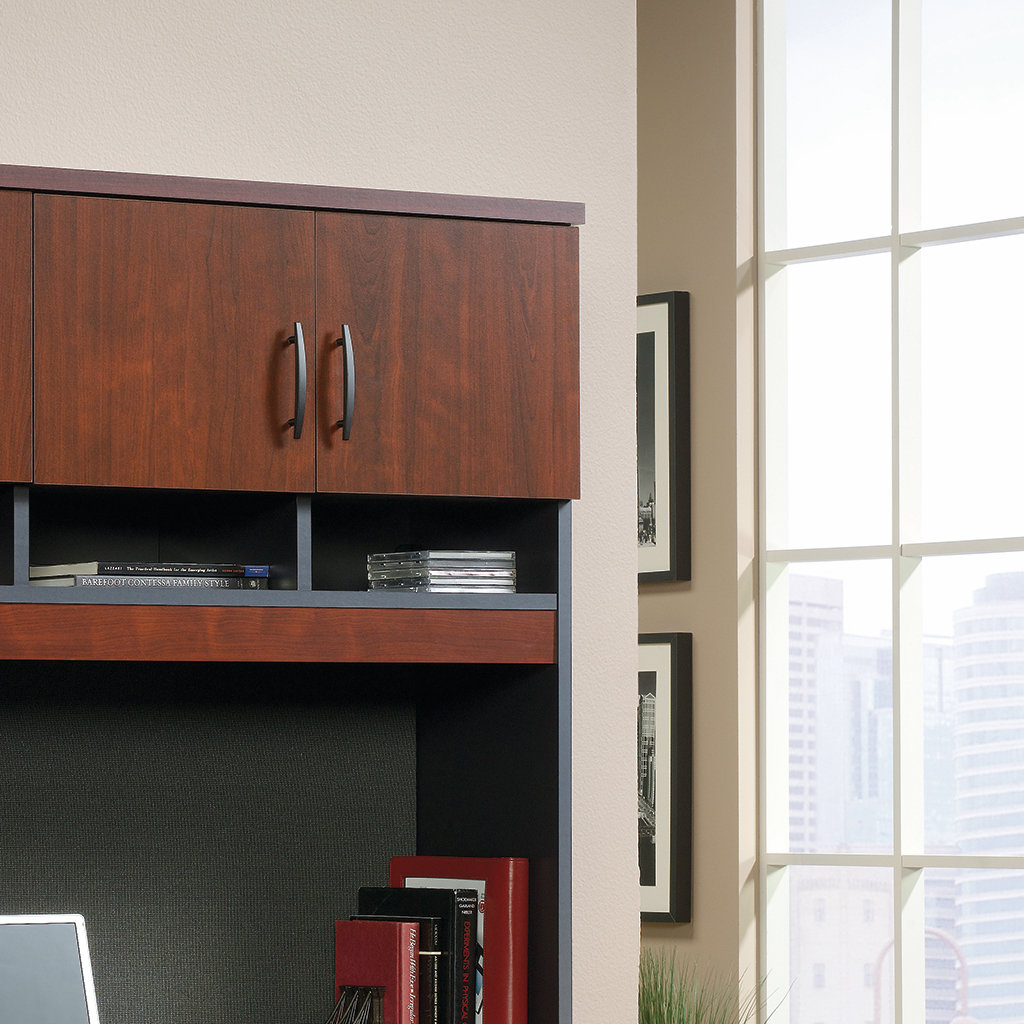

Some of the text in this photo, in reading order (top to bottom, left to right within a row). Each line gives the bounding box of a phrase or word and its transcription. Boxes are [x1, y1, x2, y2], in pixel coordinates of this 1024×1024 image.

[82, 578, 126, 586] BAREFOOT
[128, 578, 172, 587] CONTESSA
[173, 579, 203, 588] FAMILY
[204, 579, 230, 588] STYLE
[462, 921, 471, 970] EXPERIMENTS
[463, 973, 470, 982] IN
[408, 994, 416, 1023] Irregular
[461, 985, 469, 1020] PHYSICAL
